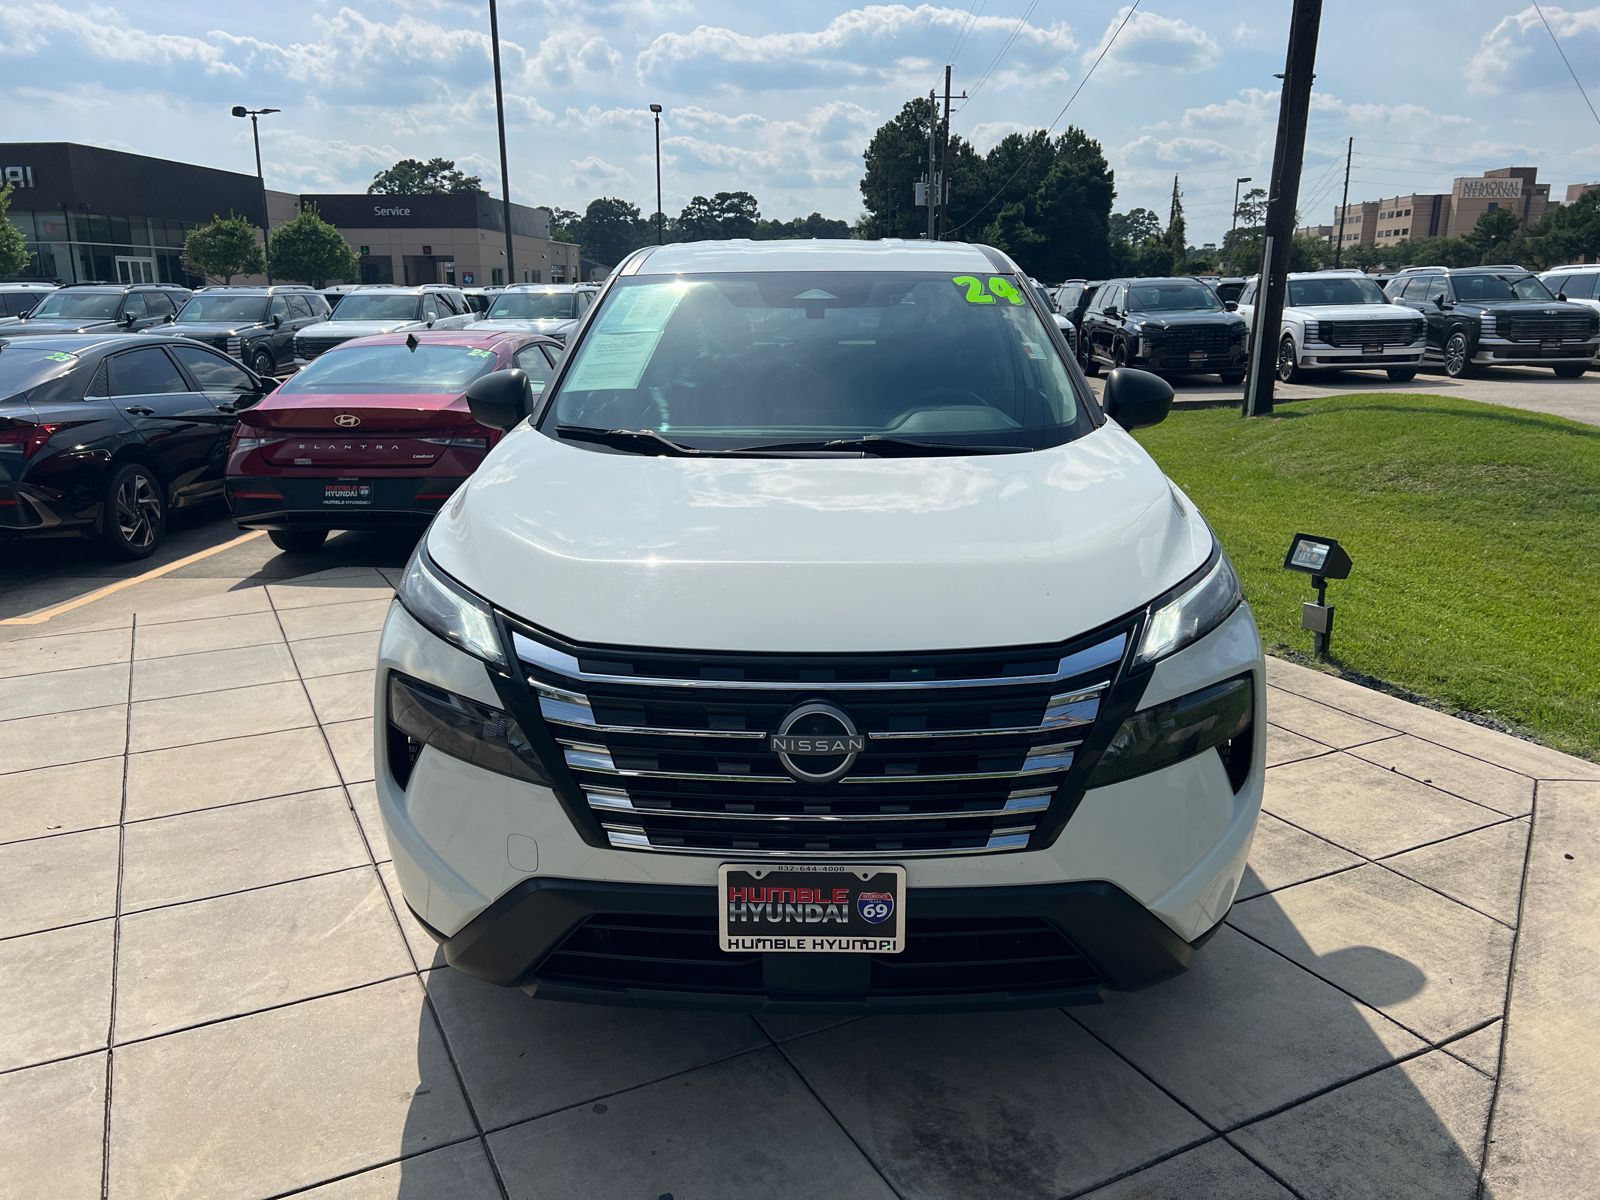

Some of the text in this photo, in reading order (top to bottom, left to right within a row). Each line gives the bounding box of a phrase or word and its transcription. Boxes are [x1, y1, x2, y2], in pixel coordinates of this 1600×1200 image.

[1465, 181, 1519, 191] MEMORIAL
[1463, 189, 1519, 198] HERMANN
[374, 206, 411, 216] Service
[952, 275, 1026, 306] 24
[466, 349, 492, 358] 24
[773, 739, 862, 751] NISSAN
[729, 886, 850, 904] HUMBLE
[729, 902, 849, 923] HYUNDAI
[863, 903, 888, 918] 69
[727, 938, 897, 951] HUMBLE HYUNDAI
